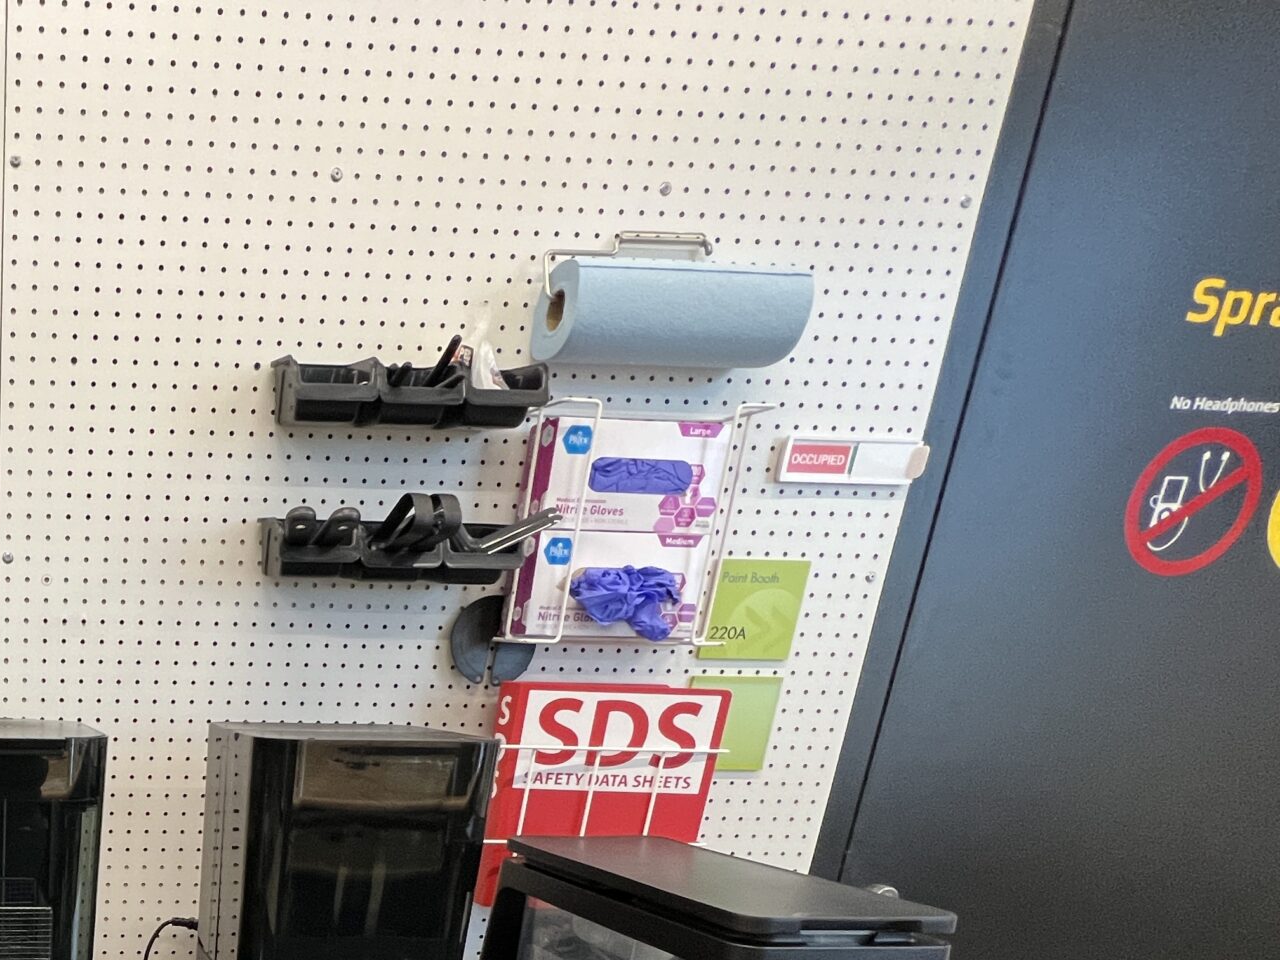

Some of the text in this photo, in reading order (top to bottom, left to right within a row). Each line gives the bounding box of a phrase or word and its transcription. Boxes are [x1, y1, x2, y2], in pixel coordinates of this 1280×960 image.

[1170, 395, 1280, 414] No Headphones
[689, 426, 712, 437] Large
[791, 453, 846, 466] OCCUPIED
[555, 504, 624, 517] Nitrie Gloves
[665, 537, 695, 546] Medium
[722, 571, 780, 584] Paint Booth
[537, 611, 570, 622] Nitrie
[709, 626, 746, 640] 220A
[534, 697, 703, 770] SDS
[587, 773, 628, 788] DATA
